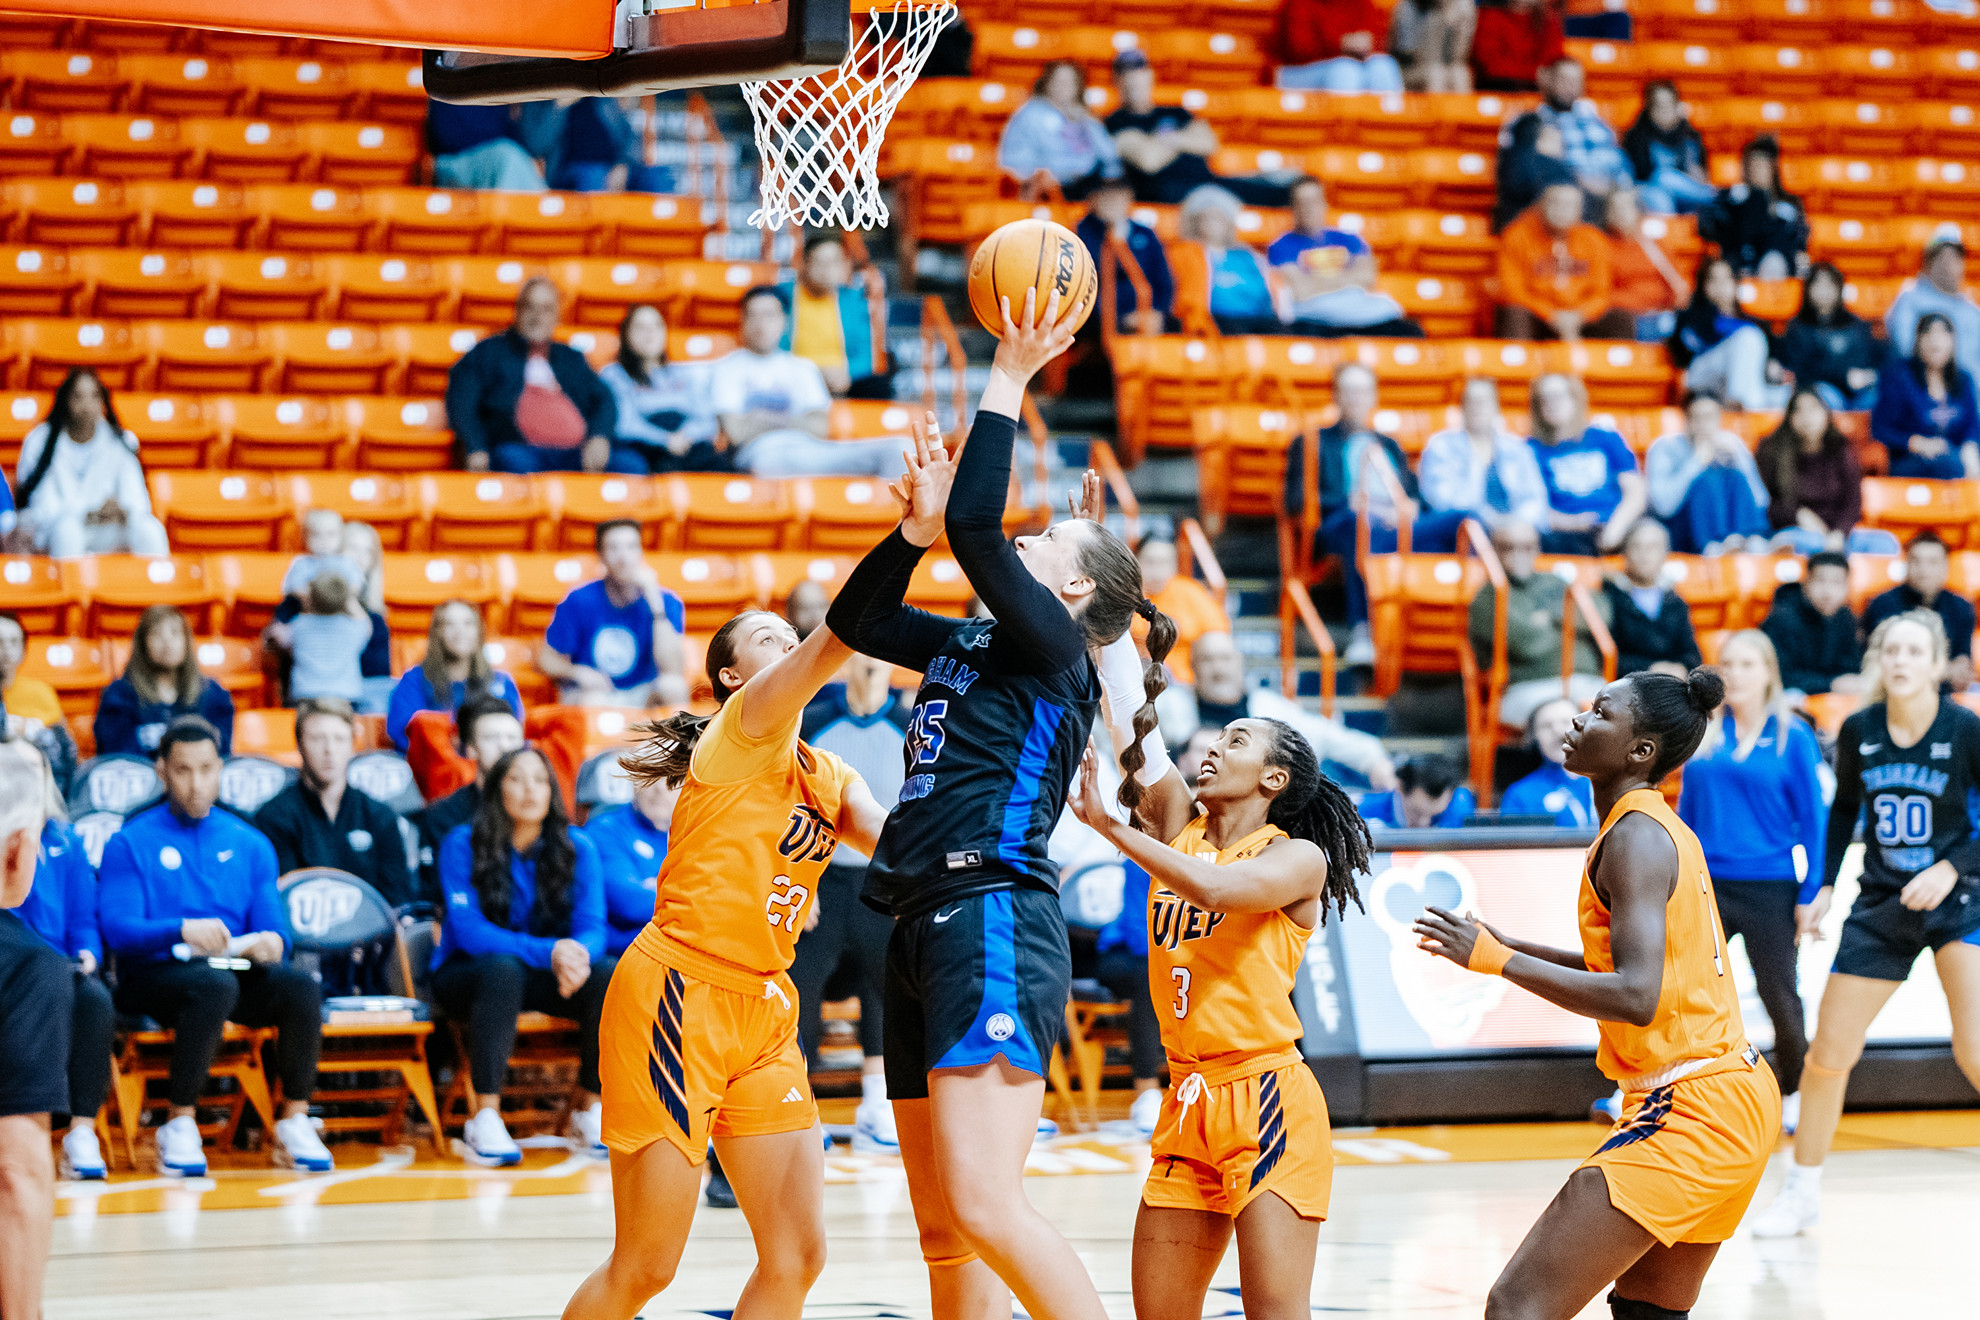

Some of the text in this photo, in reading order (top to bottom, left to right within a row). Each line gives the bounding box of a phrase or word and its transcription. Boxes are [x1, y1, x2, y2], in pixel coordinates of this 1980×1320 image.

[1055, 236, 1075, 297] NCAA
[1874, 794, 1932, 846] 30
[966, 854, 978, 864] XL
[1152, 888, 1227, 953] UTEP
[1170, 965, 1192, 1020] 3
